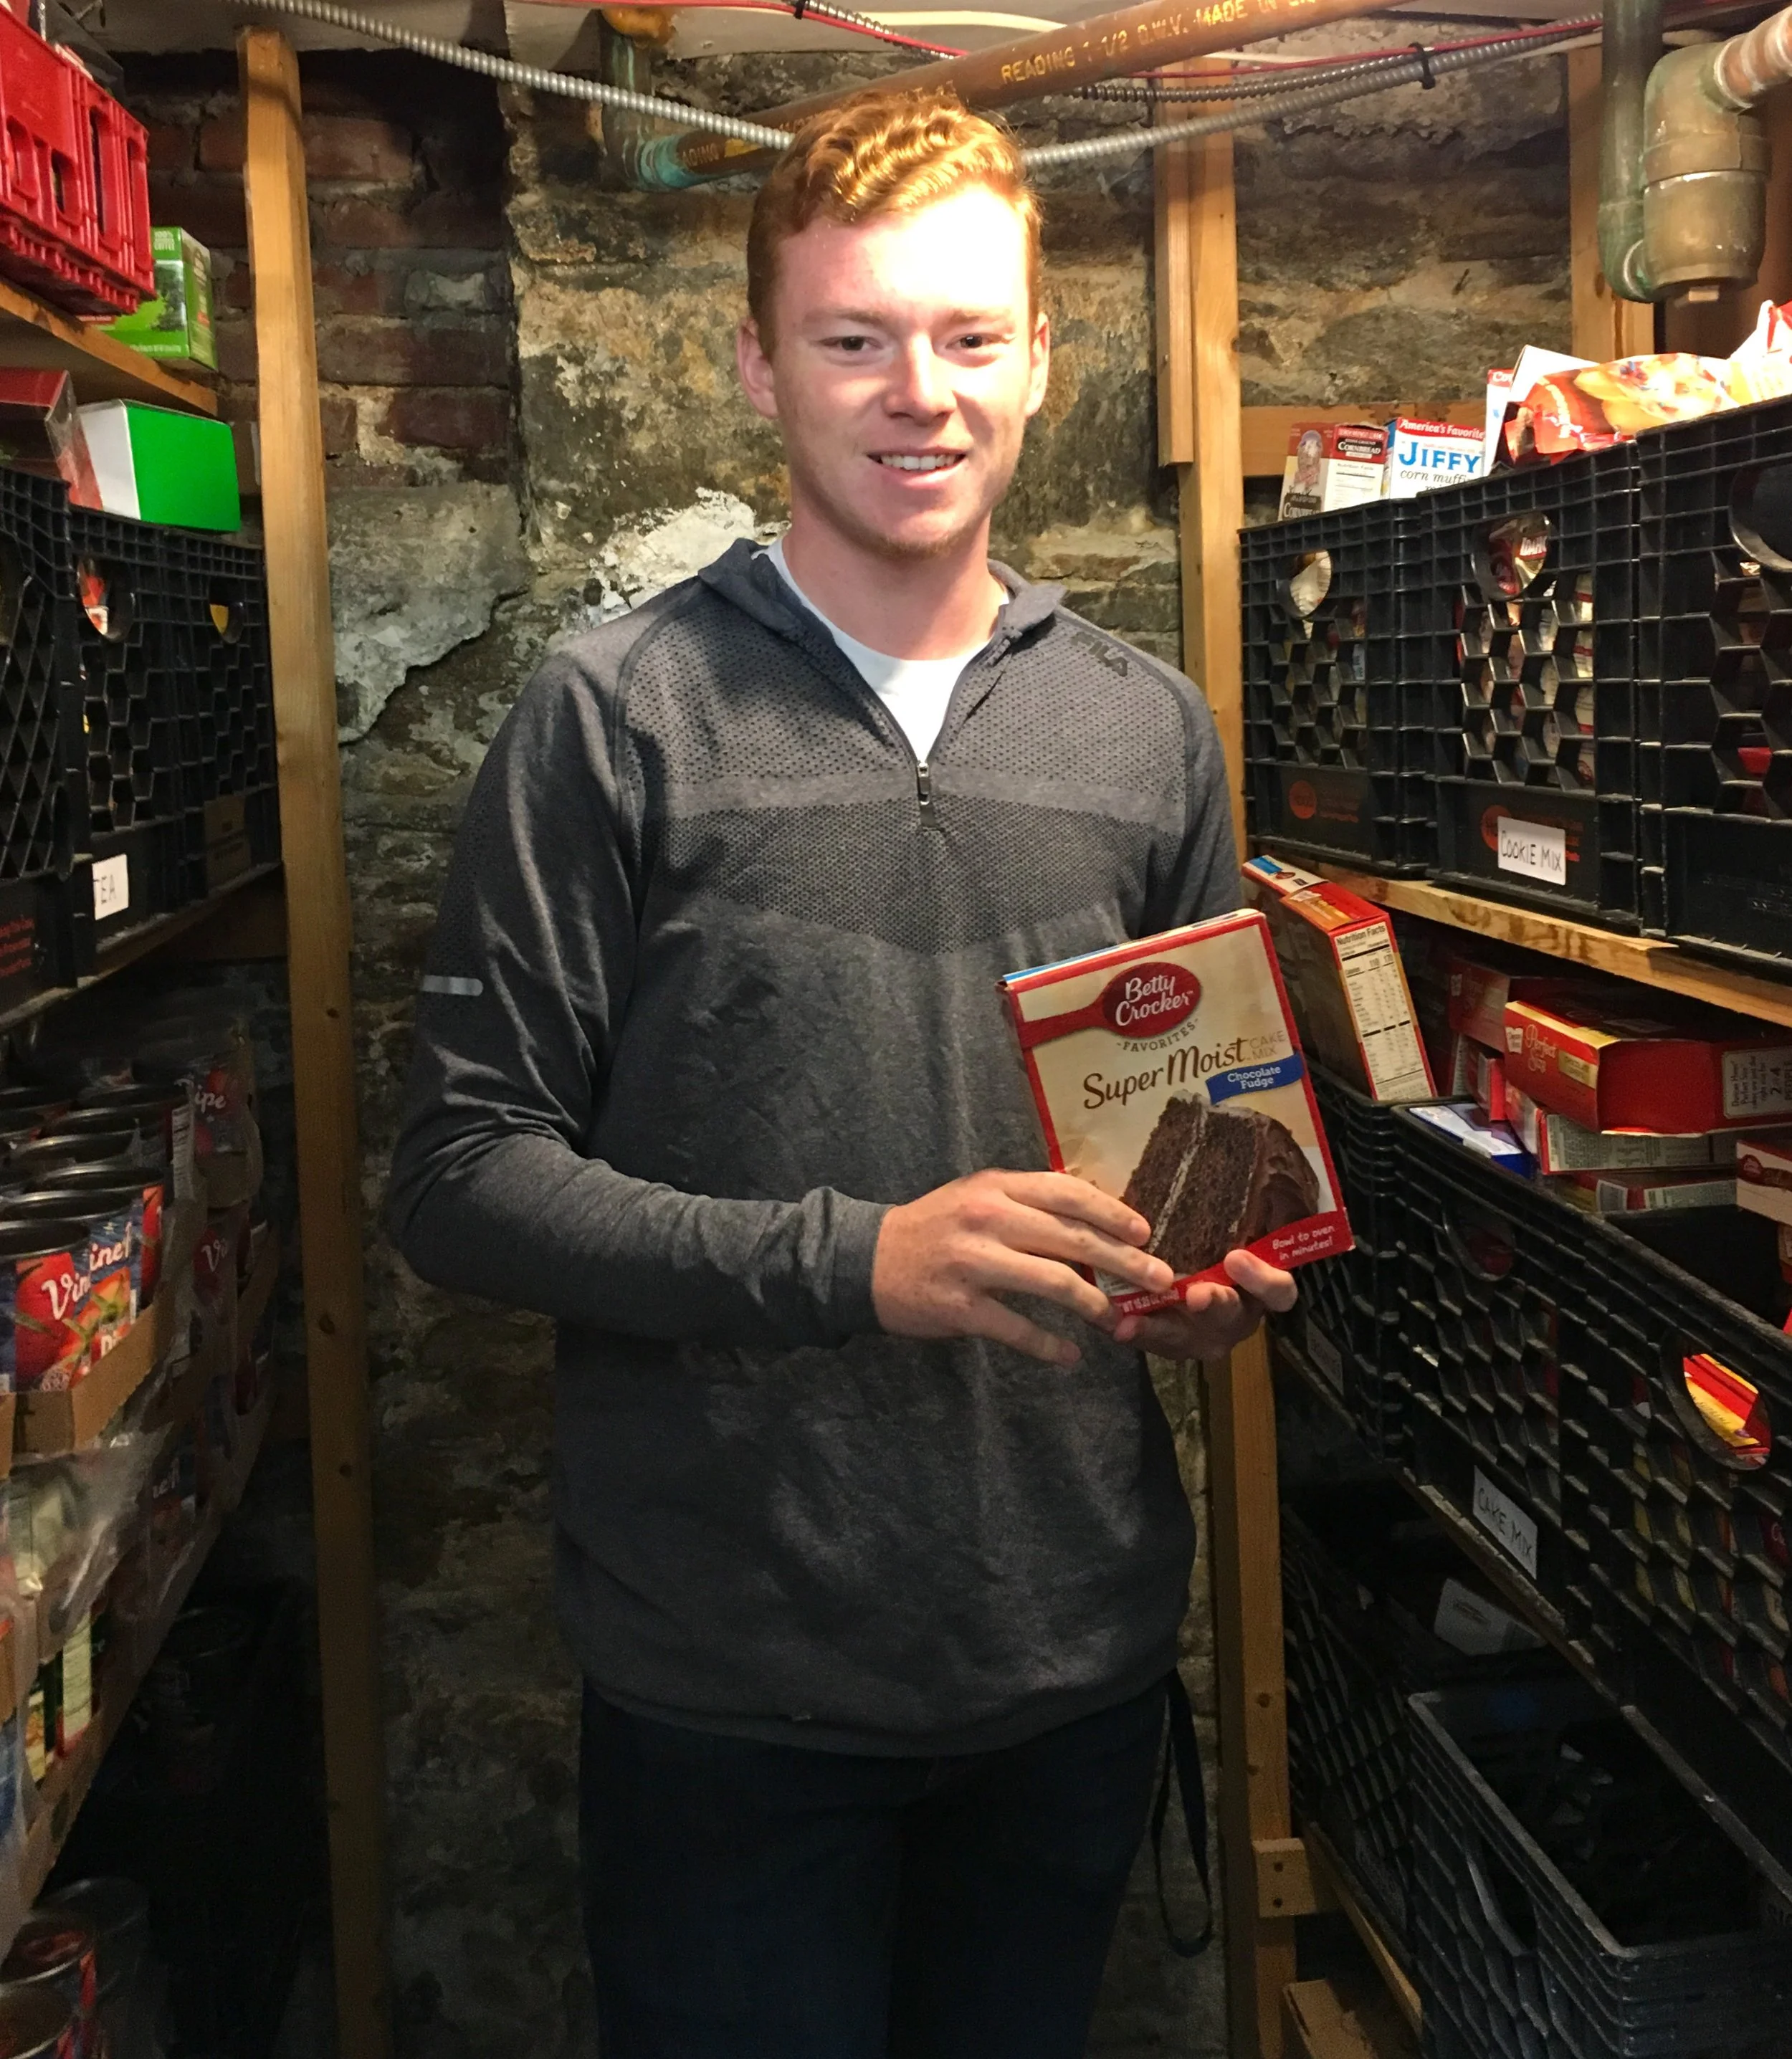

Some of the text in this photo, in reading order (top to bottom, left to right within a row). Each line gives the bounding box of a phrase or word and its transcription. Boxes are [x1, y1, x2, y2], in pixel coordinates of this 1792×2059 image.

[1001, 45, 1076, 85] READING
[1195, 0, 1248, 27] MADE
[1399, 419, 1446, 435] America's
[1447, 424, 1485, 439] Favorite
[1338, 441, 1381, 455] CORNBREAD
[1398, 441, 1481, 474] JIFFY
[1400, 469, 1469, 485] corn muffi
[1501, 829, 1537, 866] COOKIE
[1540, 845, 1562, 873] MIX
[1336, 925, 1386, 945] Nutrition Facts
[1125, 974, 1176, 1003] Betty
[1115, 991, 1191, 1026] Crocker
[1249, 1030, 1286, 1049] CAKE
[1252, 1046, 1278, 1060] MIX
[1227, 1066, 1282, 1083] Chocolate
[1240, 1077, 1274, 1090] Fudge
[1272, 1226, 1335, 1251] Bowl to oven
[89, 1240, 125, 1271] ine
[1279, 1251, 1290, 1261] in
[41, 1271, 91, 1320] Vin
[1479, 1486, 1534, 1564] CAKE MIX
